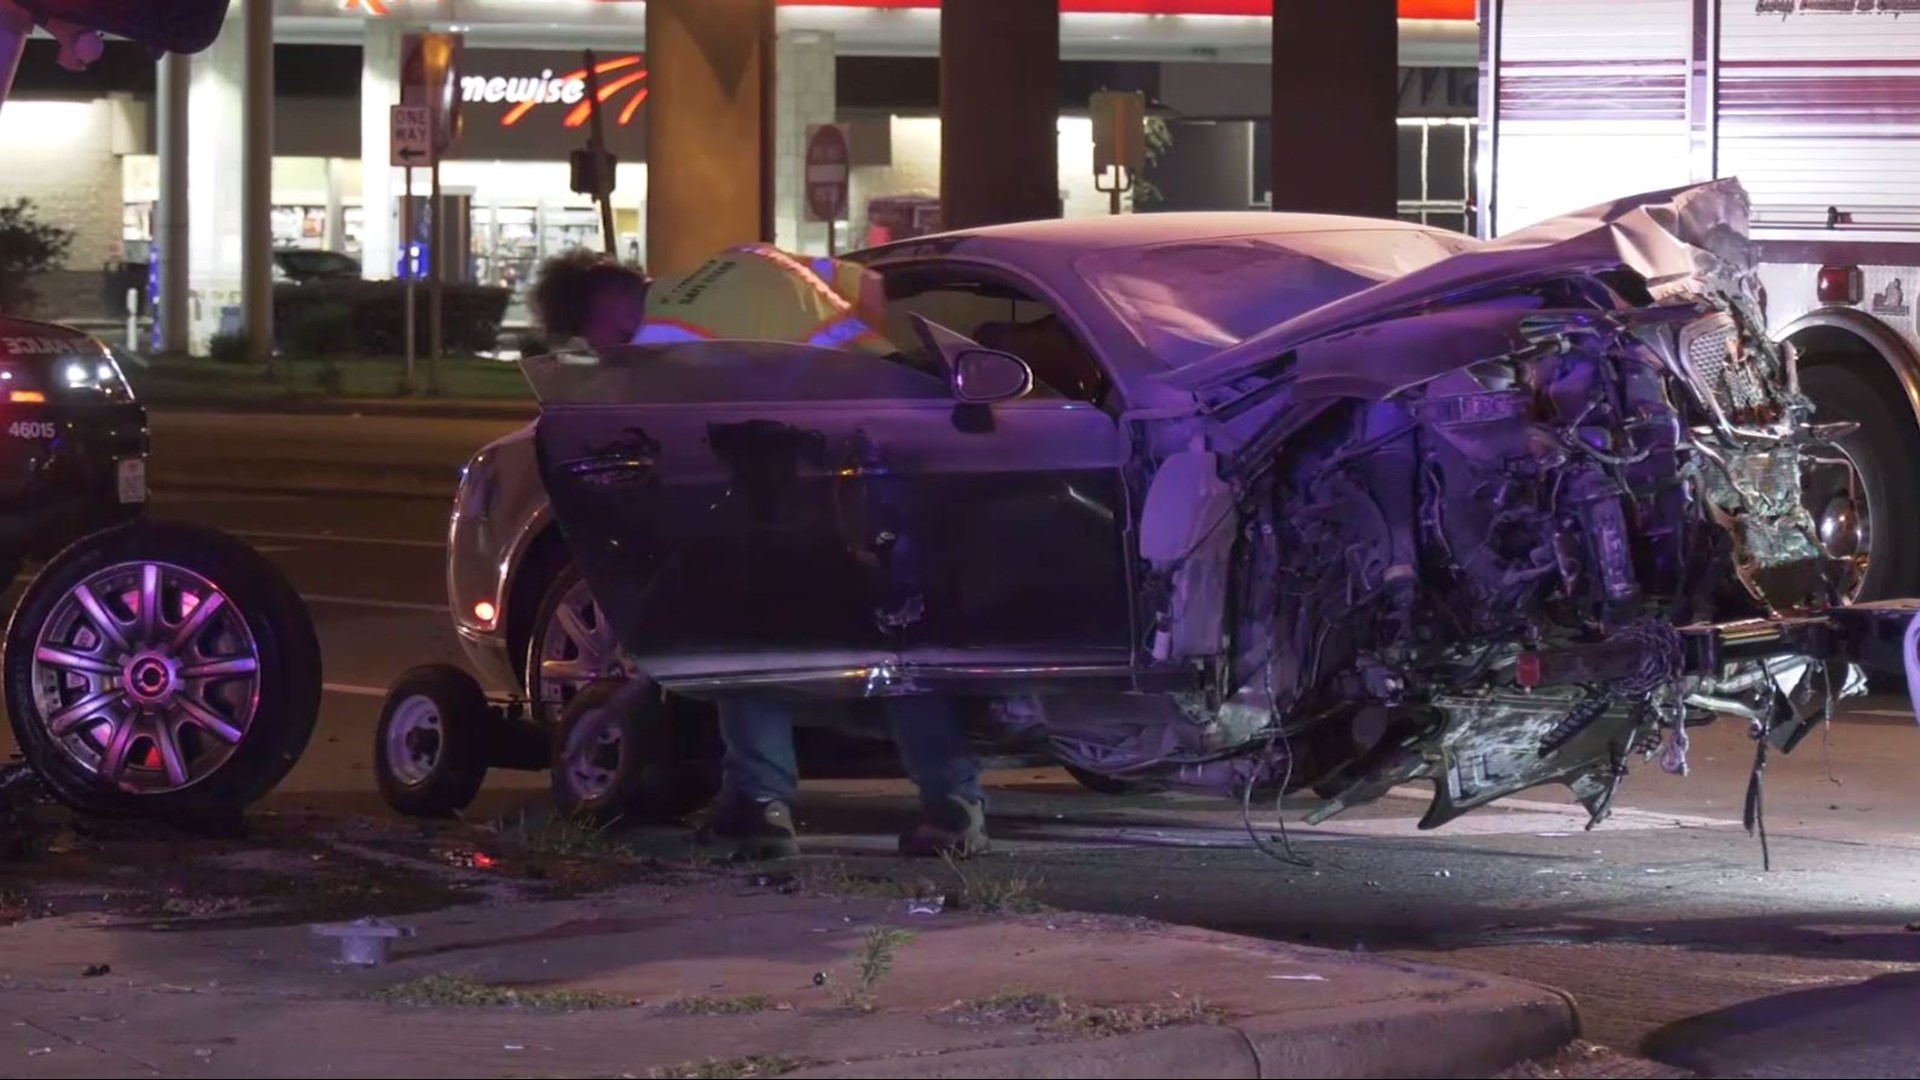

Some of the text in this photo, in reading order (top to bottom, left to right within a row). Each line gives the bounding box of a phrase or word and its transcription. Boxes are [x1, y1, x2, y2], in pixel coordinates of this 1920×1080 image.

[395, 109, 427, 125] ONE
[395, 127, 427, 141] WAY
[9, 421, 56, 438] 46015
